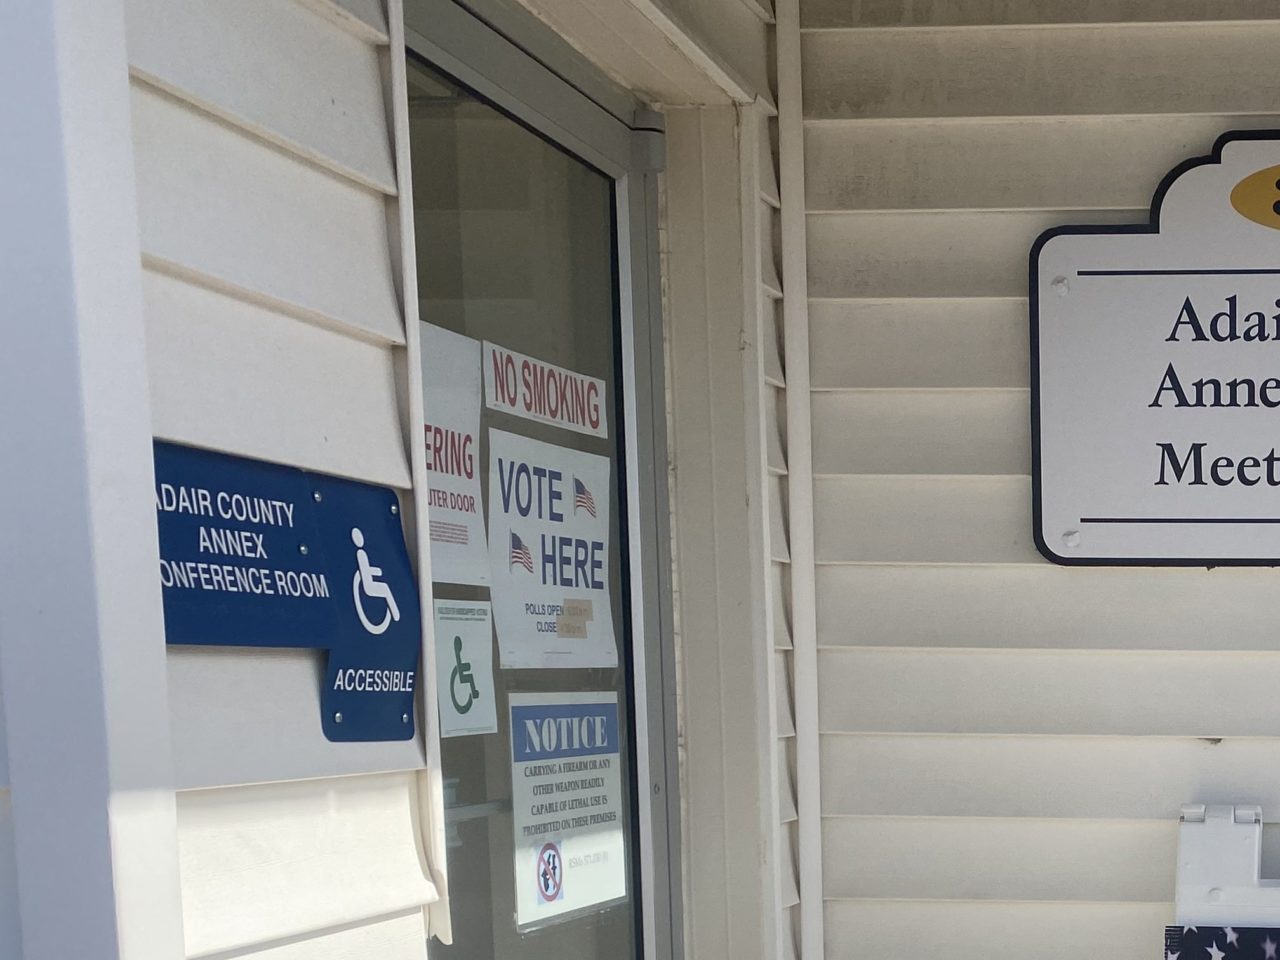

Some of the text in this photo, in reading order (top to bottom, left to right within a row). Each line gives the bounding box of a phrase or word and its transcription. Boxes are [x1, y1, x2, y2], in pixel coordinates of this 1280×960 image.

[492, 349, 600, 429] NO SMOKING
[424, 424, 474, 480] ERING
[450, 492, 476, 514] DOOR
[498, 457, 565, 523] VOTE
[216, 491, 294, 528] COUNTY
[199, 526, 268, 559] ANNEX
[541, 533, 605, 590] HERE
[160, 559, 330, 598] ONFERENCE ROOM
[525, 603, 546, 616] POLLS
[546, 604, 565, 617] OPEN
[536, 621, 558, 633] CLOSE
[333, 668, 415, 693] ACCESSIBLE
[524, 715, 608, 753] NOTICE
[524, 758, 611, 777] CARRYING A FIREARM OR ANY
[533, 777, 605, 796] OTHER WEAPON READILY
[531, 795, 608, 816] CAPABLE OF LETHAL USE IS
[522, 812, 616, 836] PROHIBITED ON THESE PREMISES
